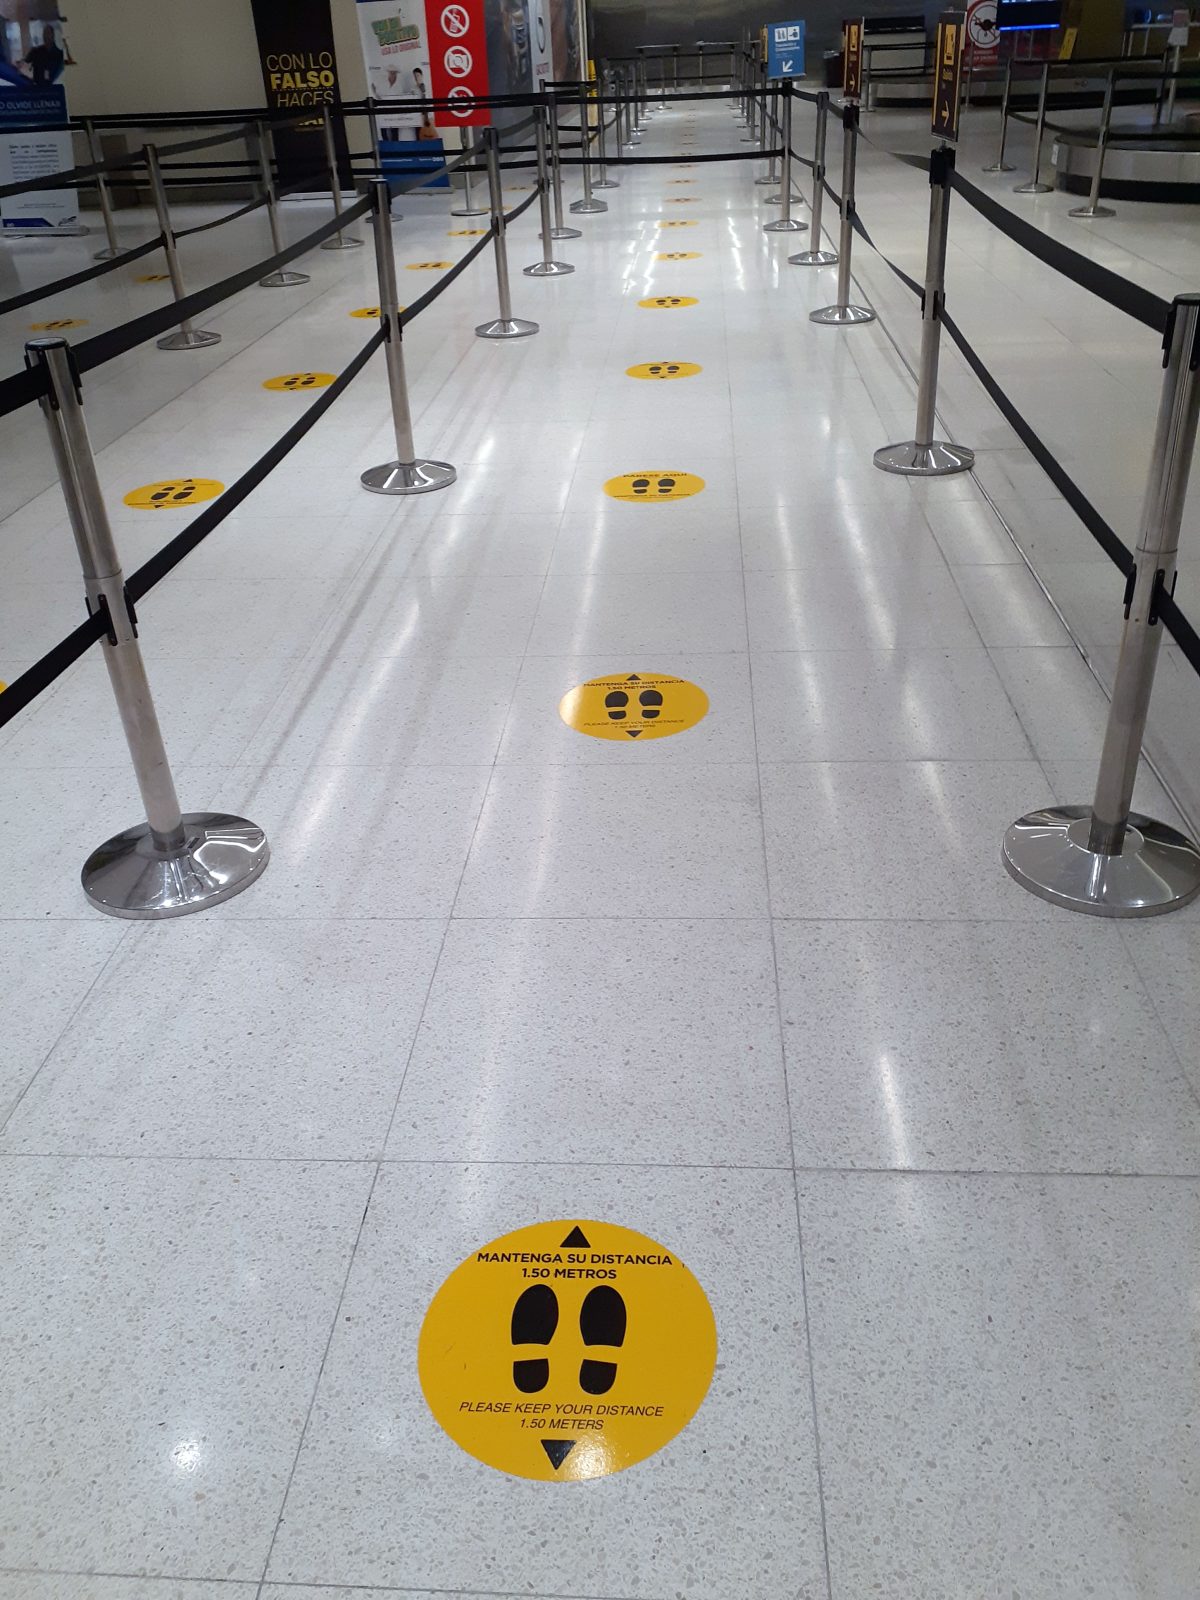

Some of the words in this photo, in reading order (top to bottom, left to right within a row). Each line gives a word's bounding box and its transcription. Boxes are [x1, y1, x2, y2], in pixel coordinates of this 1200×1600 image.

[266, 53, 306, 72] CON
[309, 51, 333, 69] LO
[270, 69, 335, 90] FALSO
[277, 90, 335, 108] HACES
[477, 1252, 563, 1264] MANTENGA
[566, 1253, 587, 1264] SU
[591, 1254, 673, 1265] DISTANCIA
[521, 1268, 551, 1278] 1.50
[554, 1268, 617, 1280] METROS
[459, 1401, 512, 1413] PLEASE
[514, 1402, 551, 1414] KEEP
[554, 1403, 592, 1415] YOUR
[596, 1405, 664, 1417] DISTANCE
[520, 1418, 546, 1429] 1.50
[548, 1418, 604, 1430] METERS
